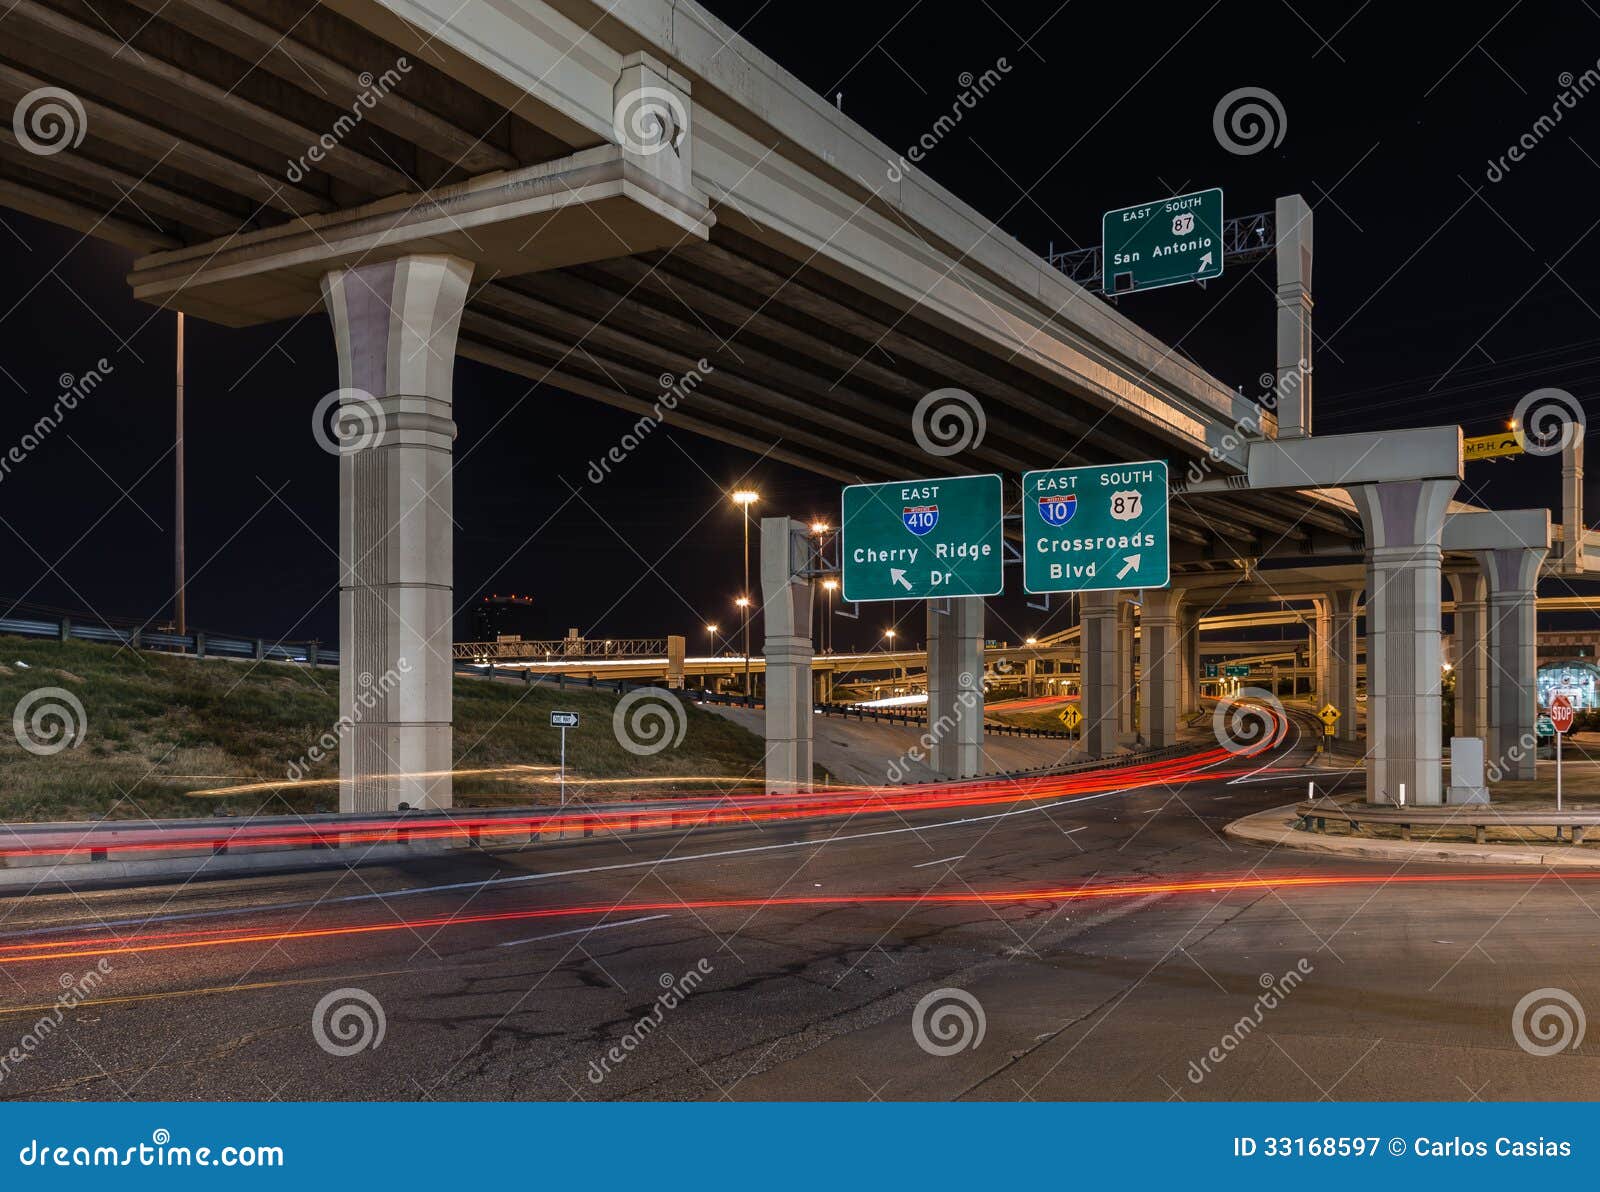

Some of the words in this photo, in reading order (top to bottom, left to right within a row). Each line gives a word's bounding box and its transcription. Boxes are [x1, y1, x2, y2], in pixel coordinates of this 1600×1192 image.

[1122, 208, 1152, 222] EAST
[1165, 197, 1202, 213] SOUTH
[1174, 217, 1192, 232] 87
[1113, 252, 1140, 265] San
[1152, 237, 1212, 258] Antonio
[1037, 476, 1078, 491] EAST
[1099, 470, 1153, 486] SOUTH
[901, 486, 940, 501] EAST
[1048, 502, 1067, 521] 10
[1113, 497, 1139, 514] 87
[908, 512, 934, 528] 410
[1036, 532, 1155, 553] Crossroads
[853, 548, 919, 564] Cherry
[936, 542, 992, 560] Ridge
[930, 570, 952, 586] Dr
[1049, 561, 1097, 580] Blvd
[1552, 706, 1571, 720] STOP
